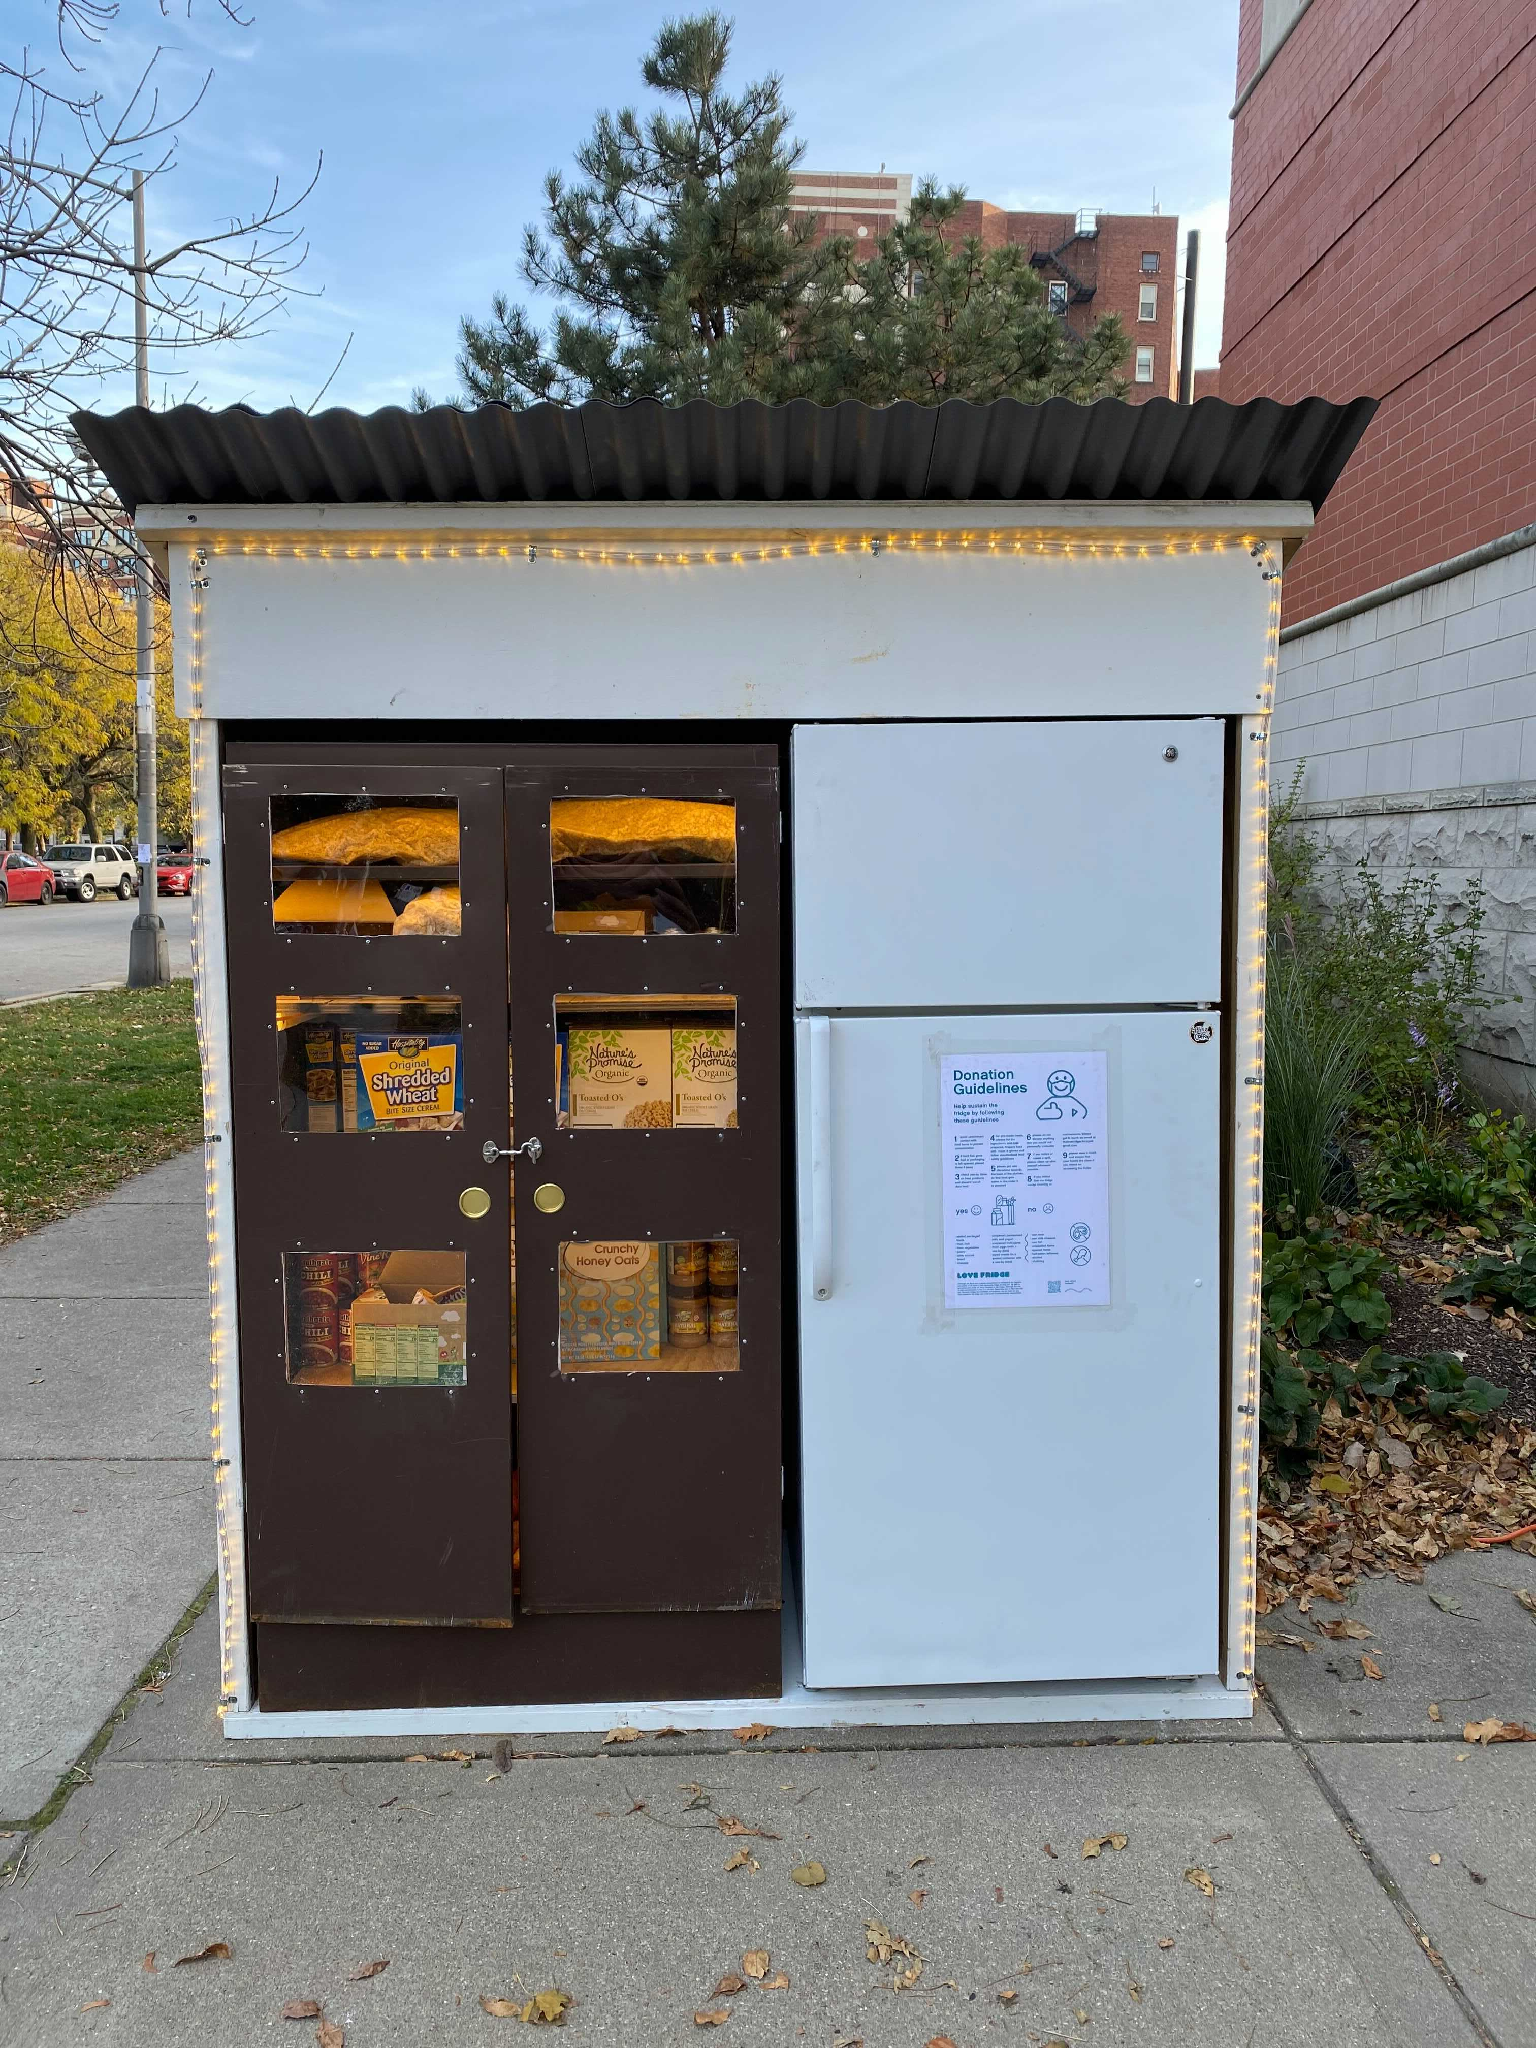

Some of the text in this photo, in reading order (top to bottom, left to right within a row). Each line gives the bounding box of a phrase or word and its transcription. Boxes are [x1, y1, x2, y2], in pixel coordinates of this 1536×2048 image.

[589, 1044, 636, 1059] Nature's
[692, 1043, 736, 1059] Nature's
[389, 1058, 430, 1071] Original
[586, 1058, 642, 1073] Promise
[689, 1058, 736, 1073] Promise
[372, 1068, 450, 1090] Shredded
[595, 1069, 630, 1080] Organic
[698, 1069, 732, 1079] Organic
[954, 1069, 1014, 1080] Donation
[954, 1082, 1028, 1094] Guidelines
[386, 1087, 438, 1105] Wheat
[595, 1244, 639, 1254] Crunchy
[576, 1256, 640, 1267] Honey Oats
[301, 1270, 331, 1280] CHILI
